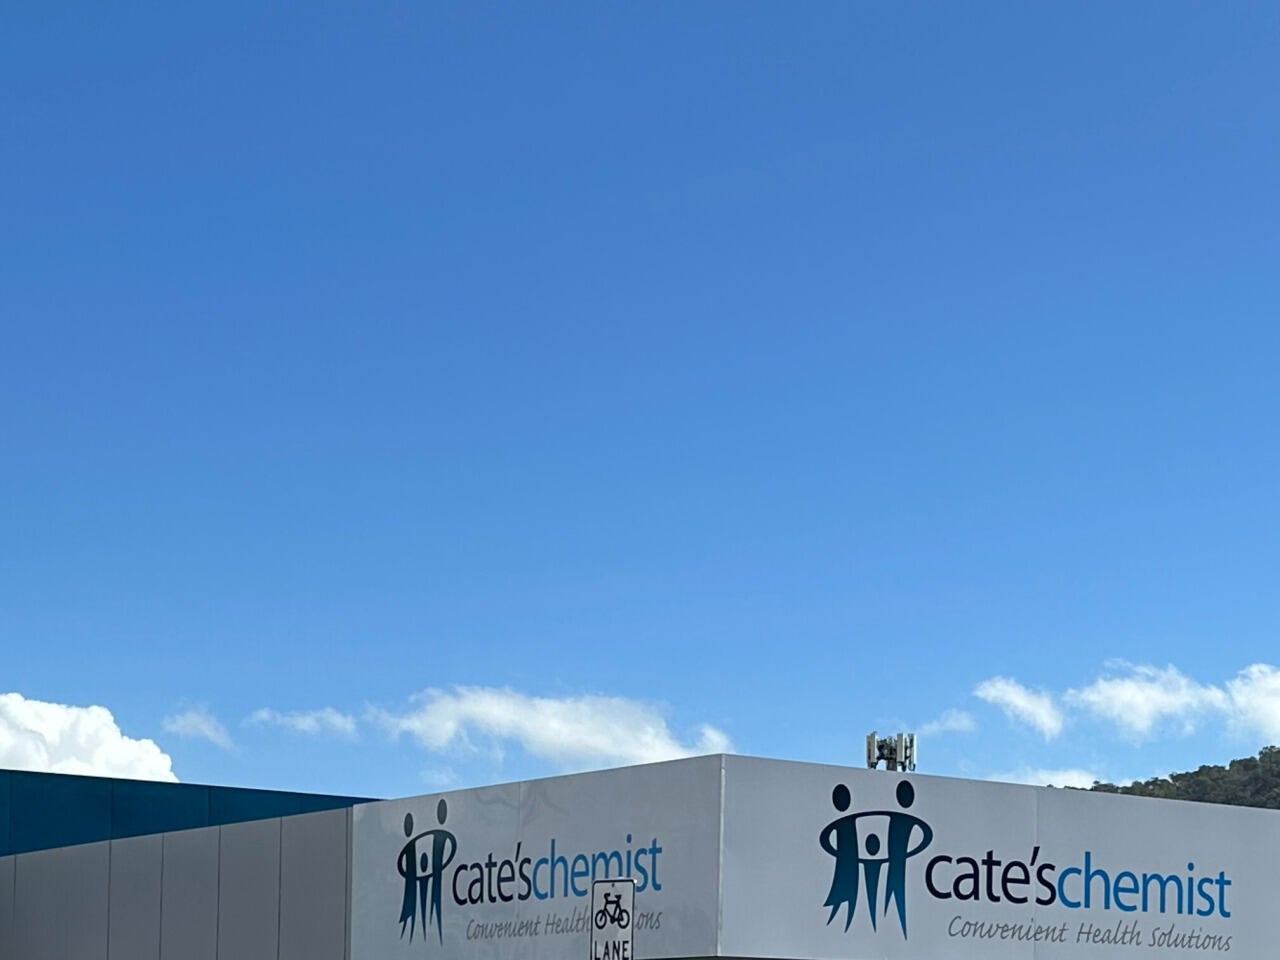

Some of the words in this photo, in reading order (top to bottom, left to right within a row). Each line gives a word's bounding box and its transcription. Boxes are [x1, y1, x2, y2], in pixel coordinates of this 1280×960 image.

[466, 918, 541, 941] Convenient
[545, 907, 591, 937] Health
[948, 915, 1069, 944] Convenient
[1076, 919, 1142, 947] Health
[1147, 925, 1232, 953] Solutions
[594, 940, 630, 960] LANE
